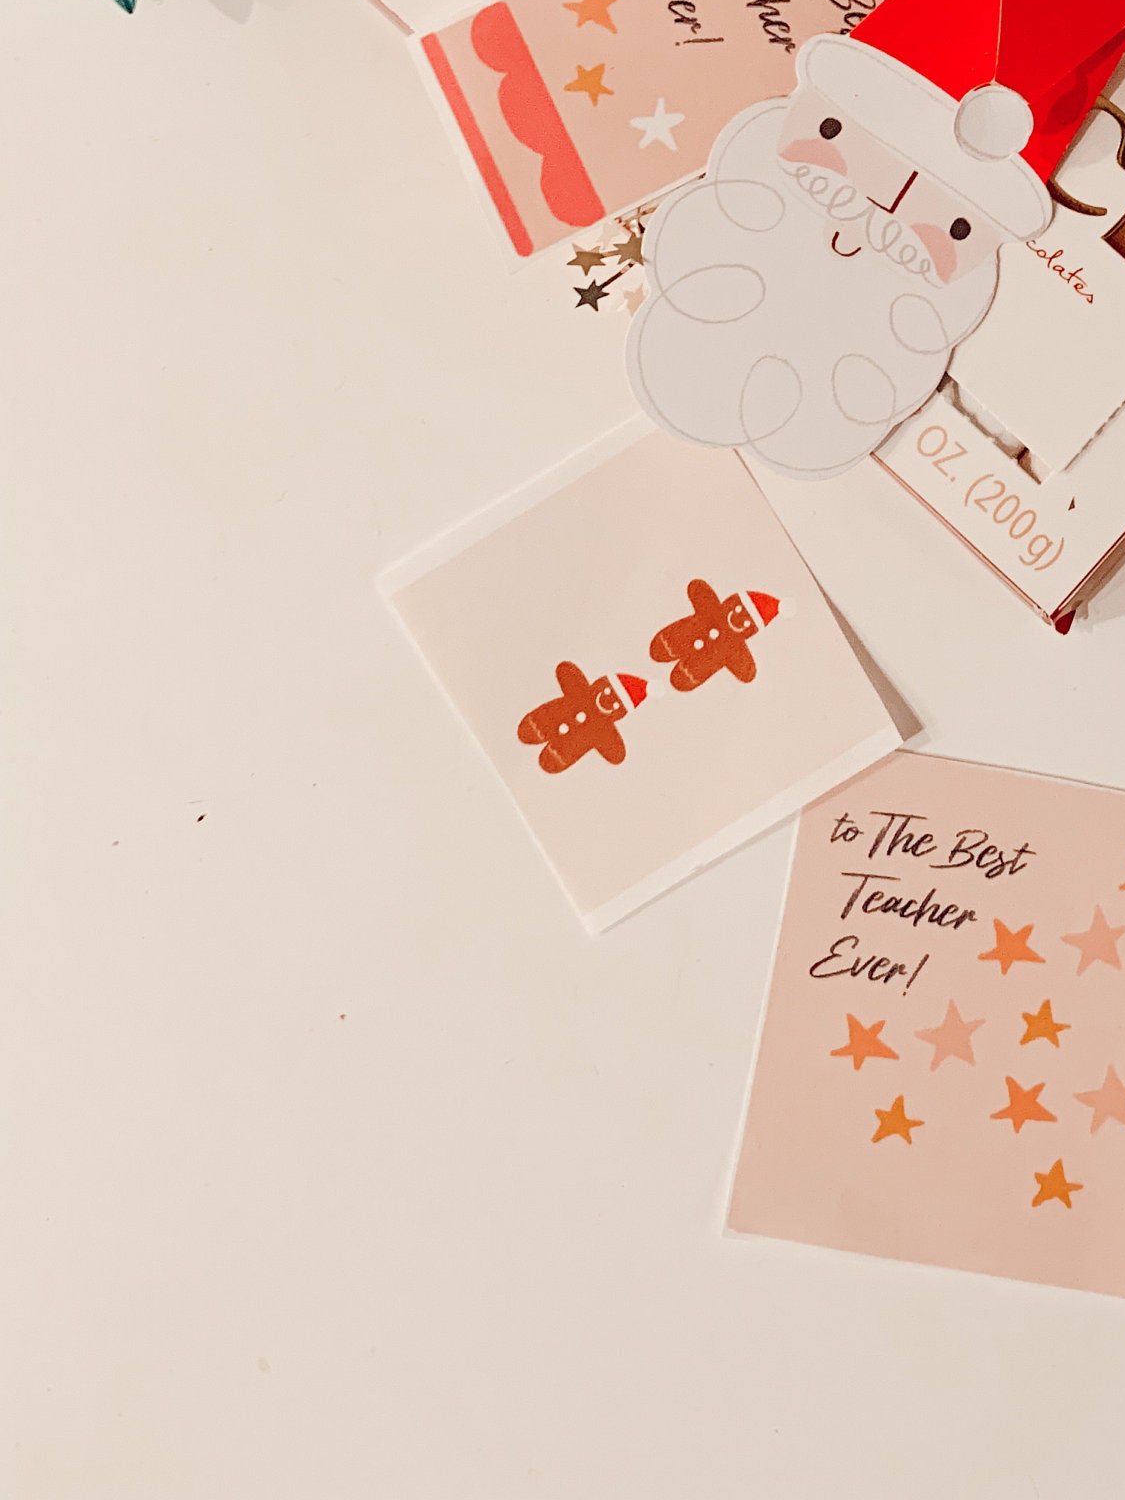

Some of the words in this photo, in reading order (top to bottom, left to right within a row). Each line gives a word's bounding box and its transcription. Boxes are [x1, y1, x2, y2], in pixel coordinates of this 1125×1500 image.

[1026, 240, 1094, 304] colates
[916, 425, 968, 482] OZ.
[964, 473, 1065, 571] (200g)
[830, 813, 863, 845] to
[867, 811, 938, 859] The
[929, 830, 1037, 878] Best
[840, 872, 978, 929] Teacher
[809, 935, 930, 997] Ever!
